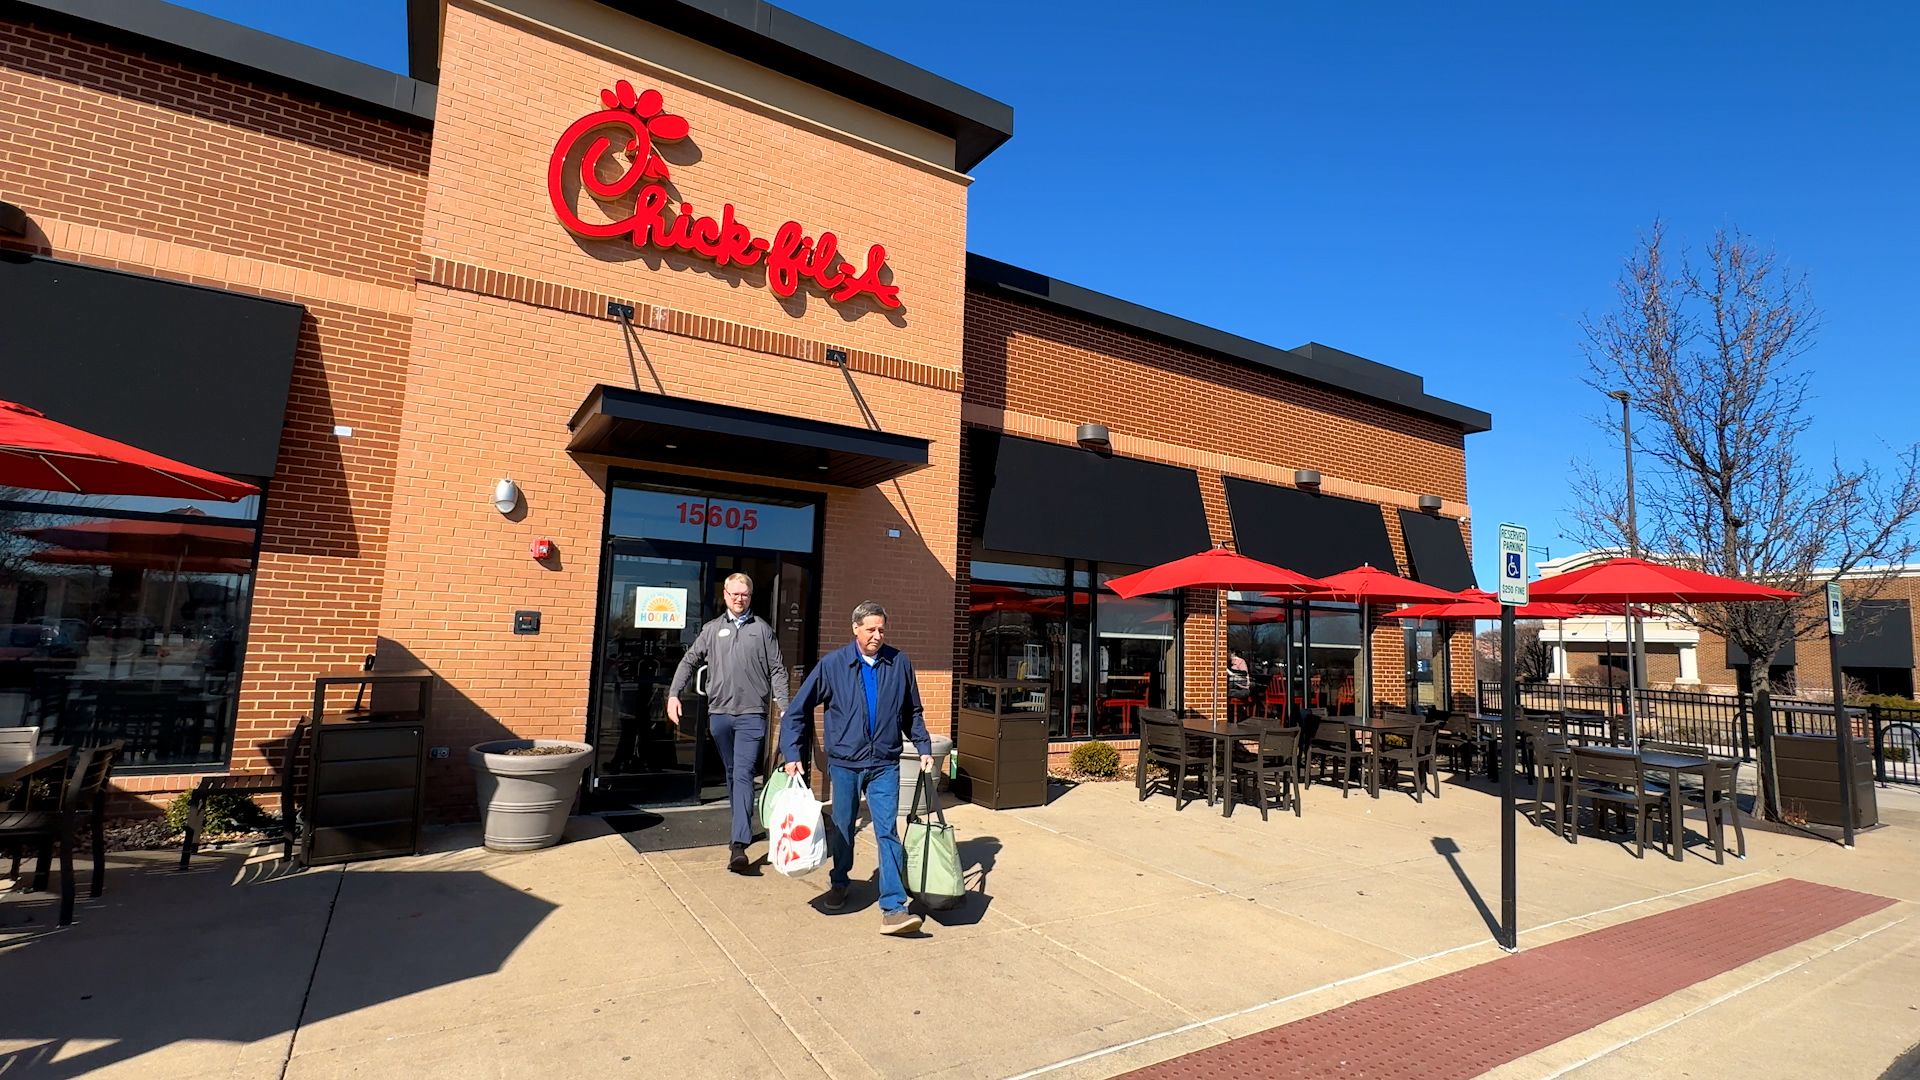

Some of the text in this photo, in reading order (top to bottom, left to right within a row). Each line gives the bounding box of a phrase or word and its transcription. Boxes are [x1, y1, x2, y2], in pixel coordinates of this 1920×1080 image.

[548, 109, 901, 309] Chick-fil-A
[676, 502, 758, 531] 15605
[1501, 528, 1526, 542] RESERVED
[1502, 540, 1524, 553] PARKING
[1502, 584, 1525, 596] $250 FINE
